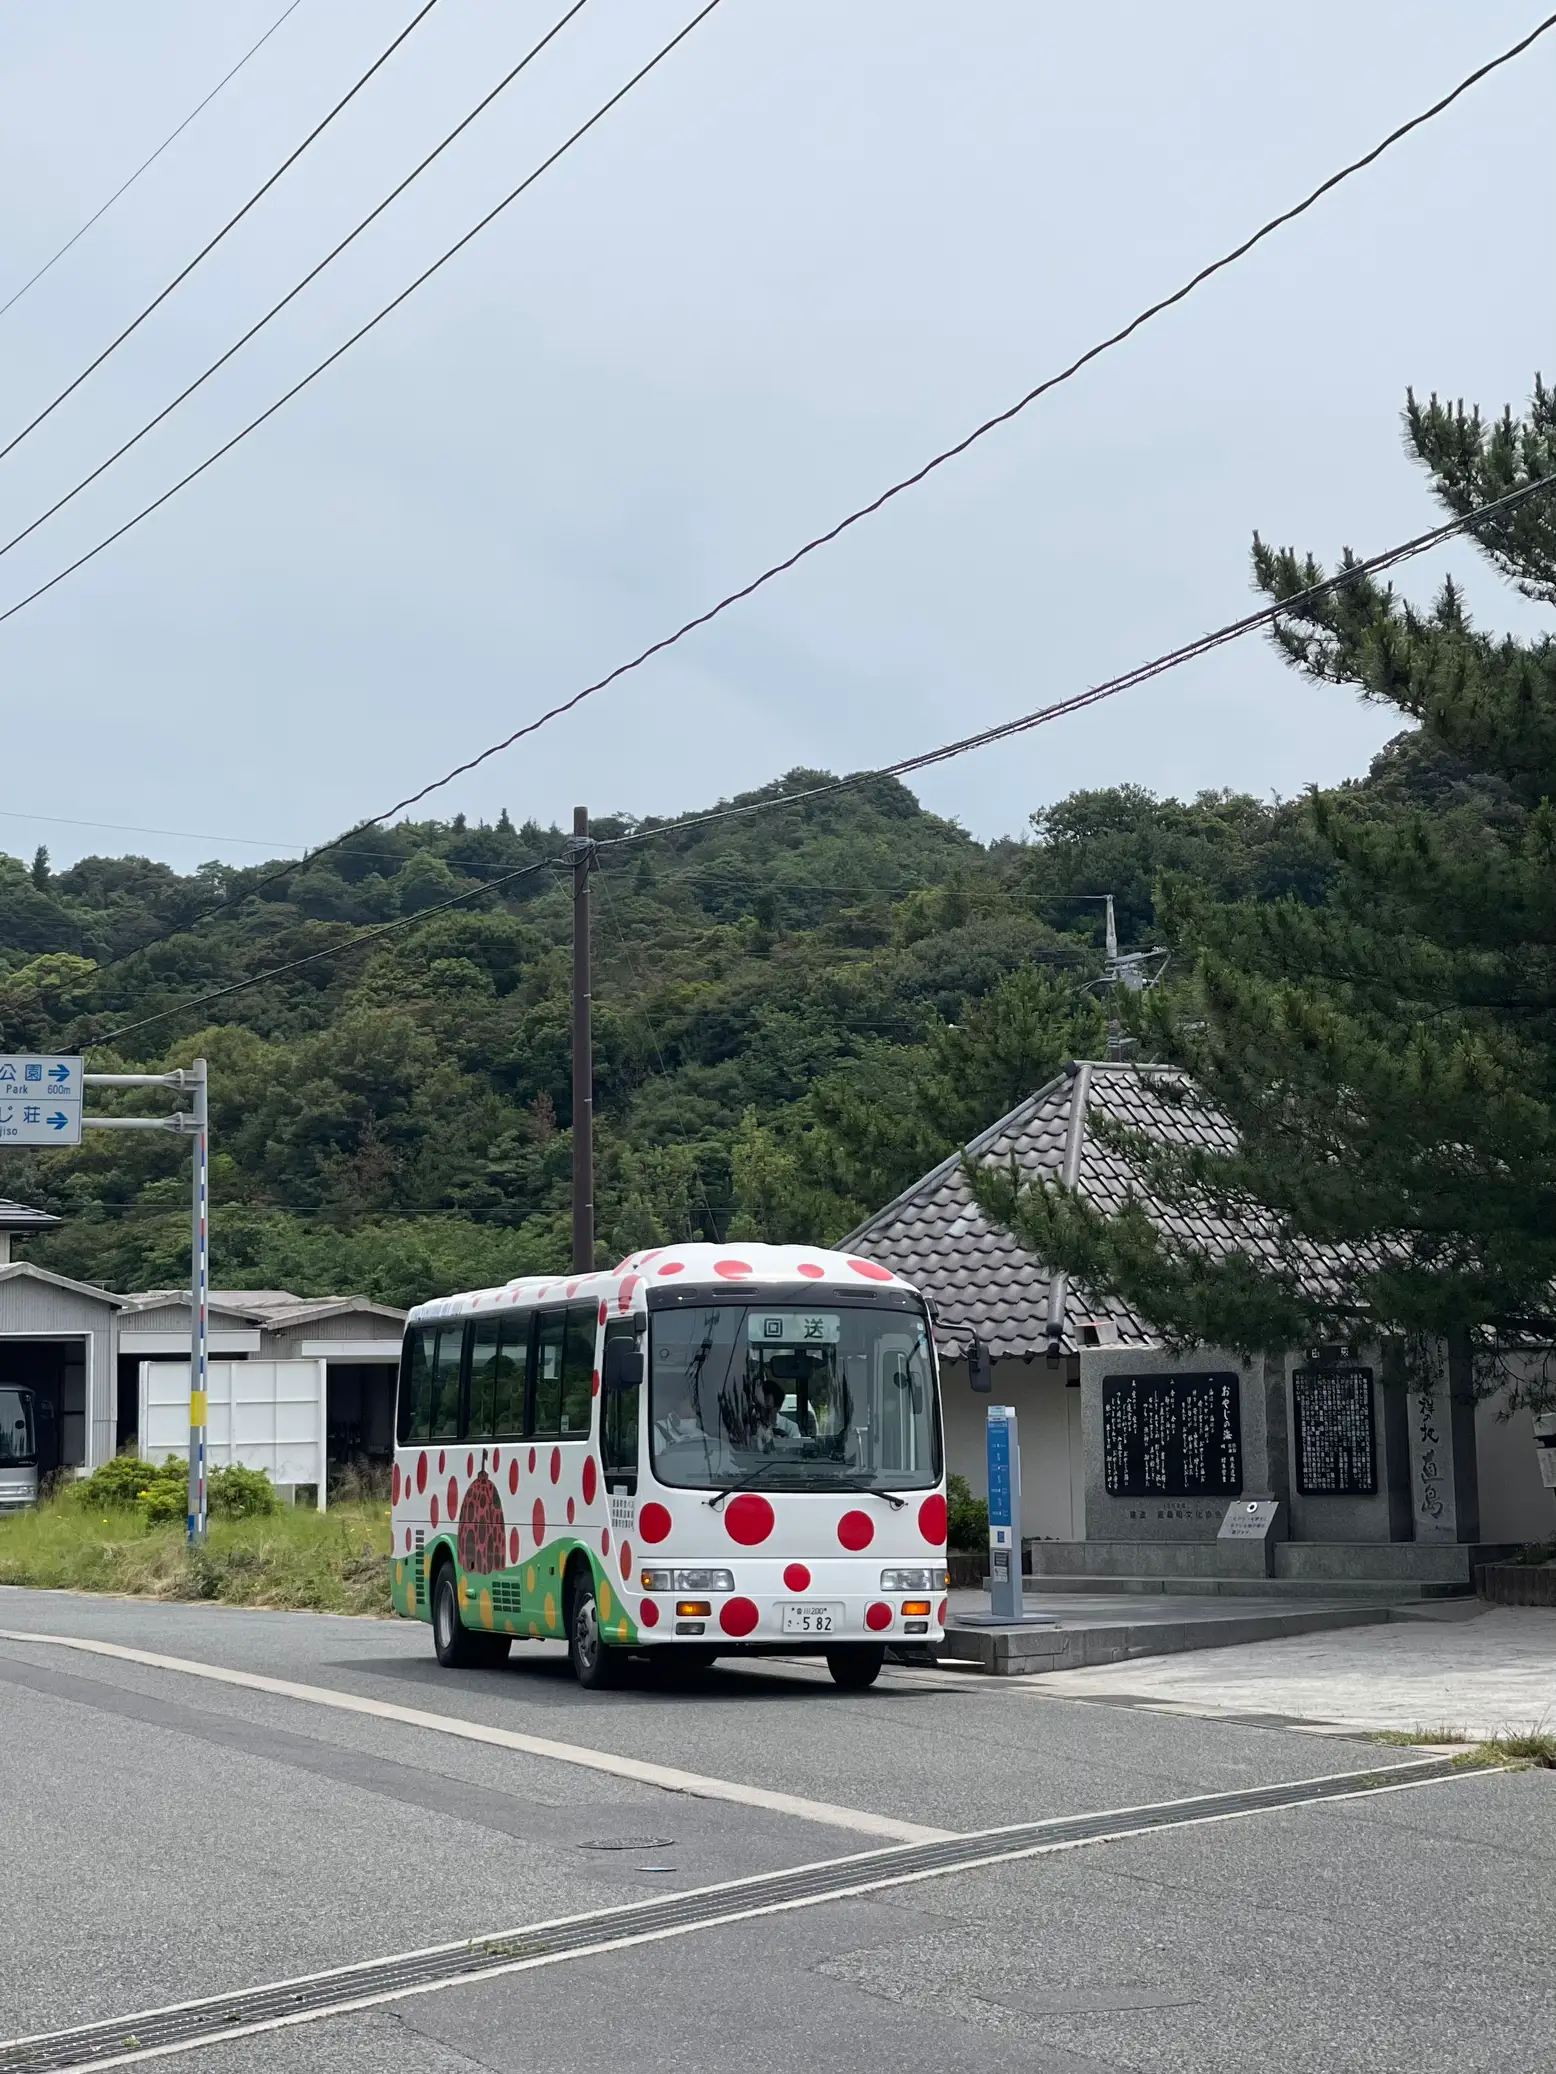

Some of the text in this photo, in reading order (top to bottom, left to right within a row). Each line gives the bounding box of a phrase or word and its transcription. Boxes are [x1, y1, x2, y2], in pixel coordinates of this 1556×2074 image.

[0, 1064, 42, 1081] 公園
[6, 1084, 28, 1094] Park
[47, 1084, 71, 1094] 600m
[764, 1318, 824, 1338] 回送
[1222, 1385, 1233, 1440] おやじの海
[1418, 1394, 1440, 1444] 祥の地
[1421, 1448, 1444, 1519] 直島
